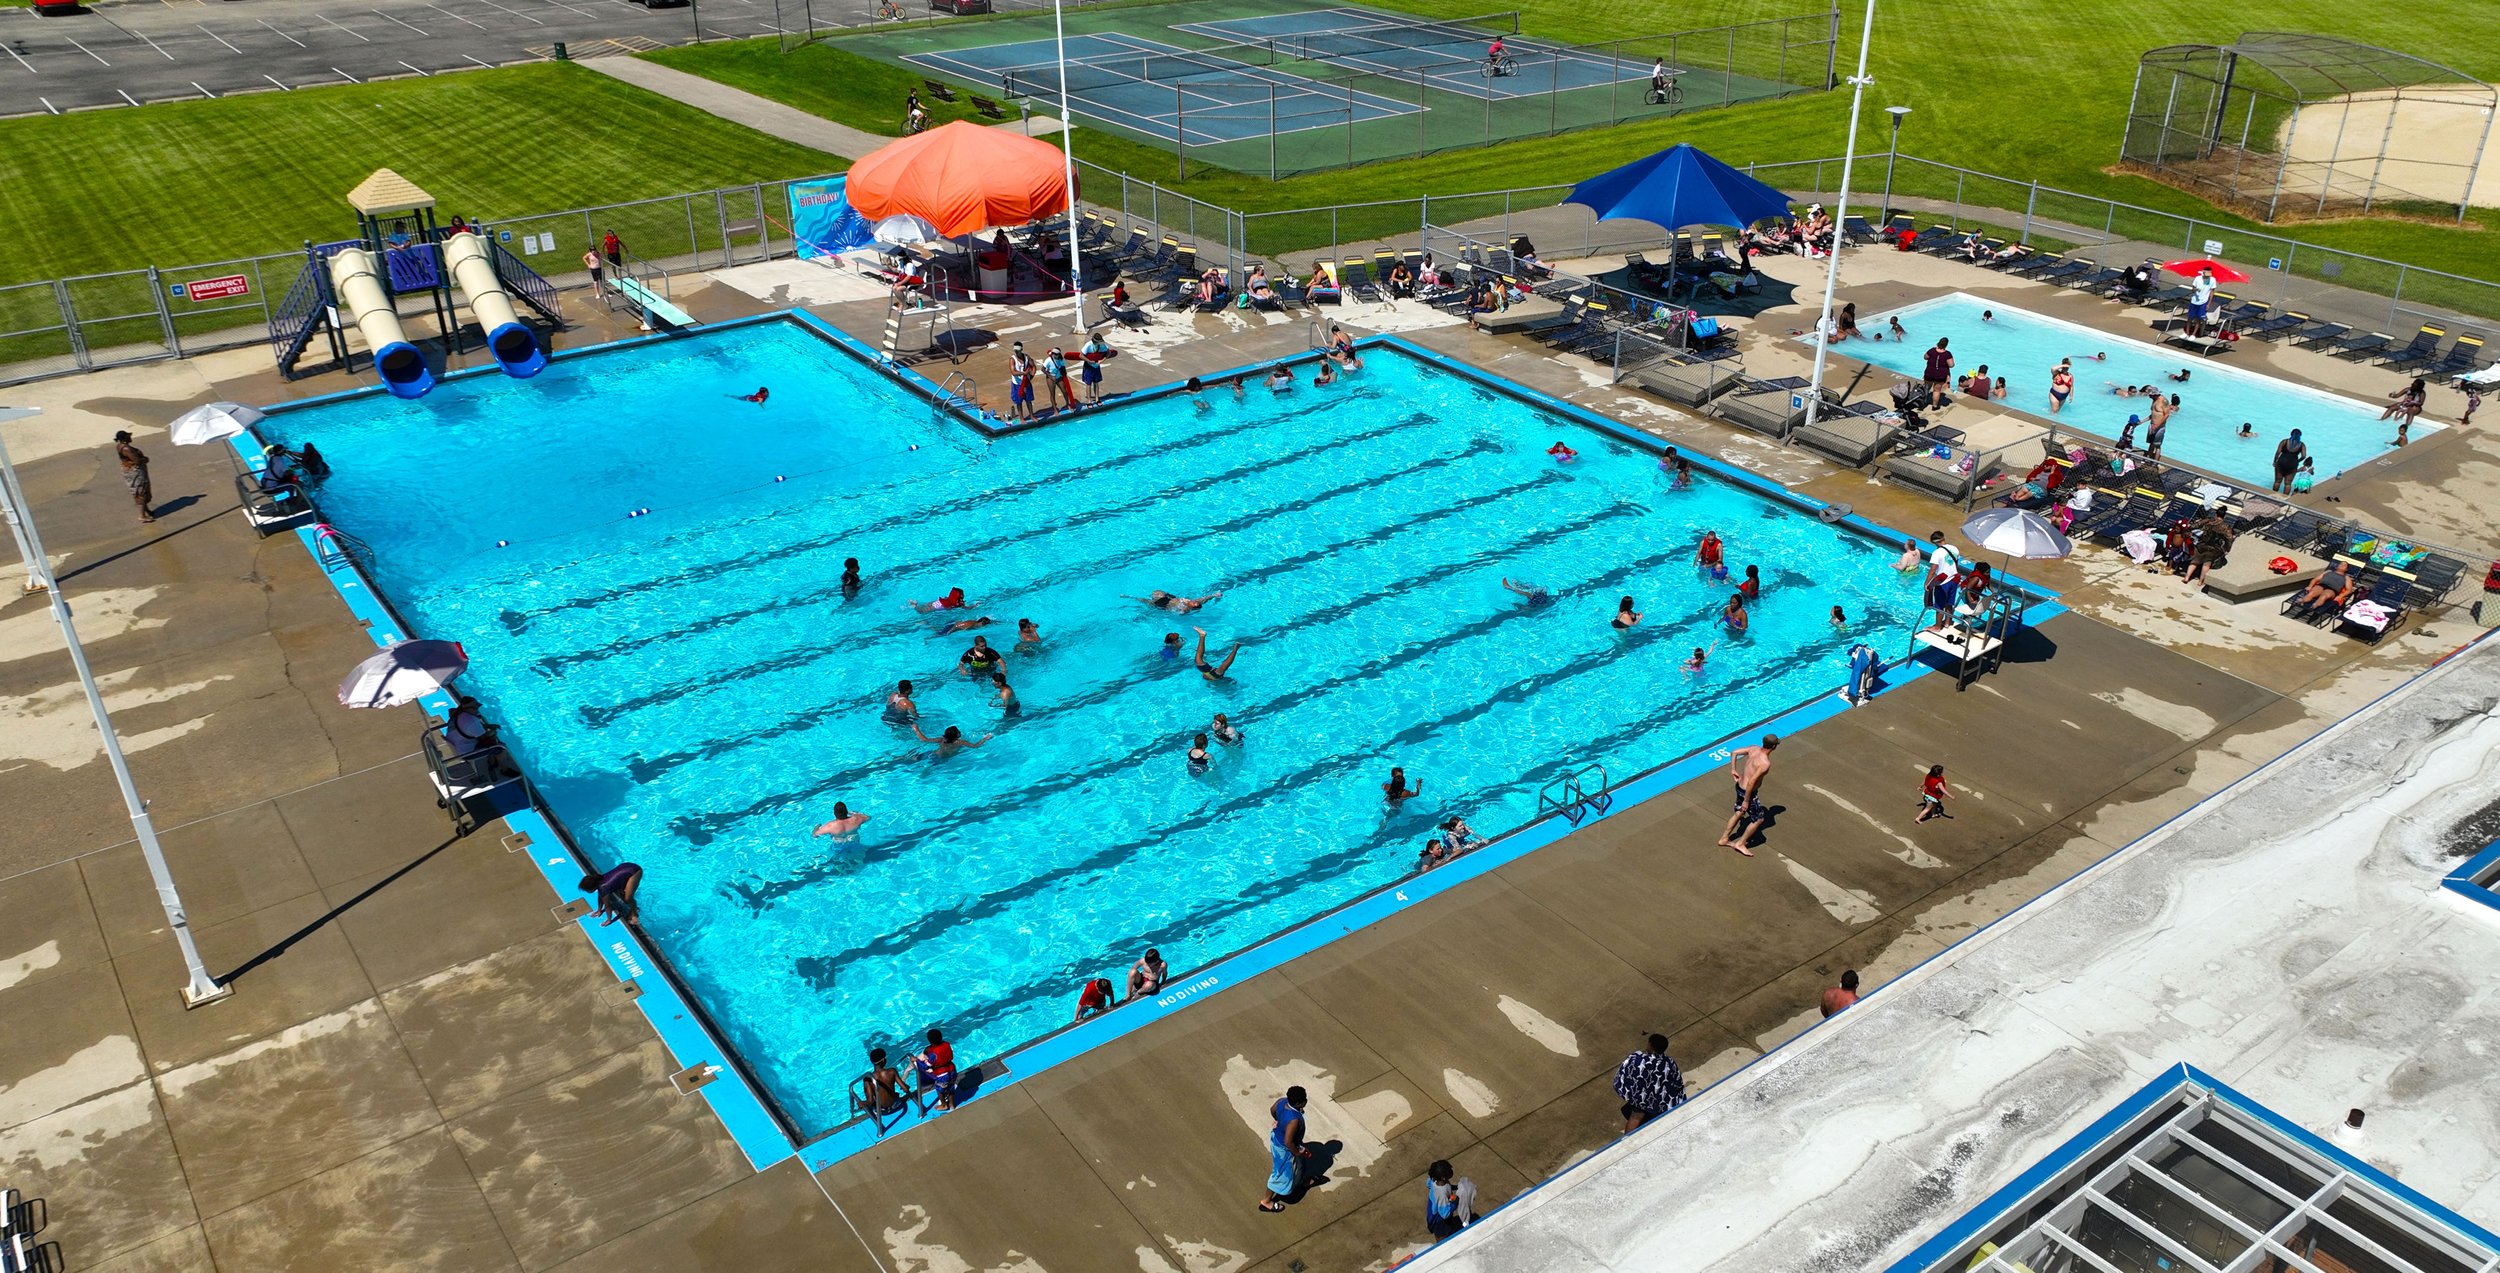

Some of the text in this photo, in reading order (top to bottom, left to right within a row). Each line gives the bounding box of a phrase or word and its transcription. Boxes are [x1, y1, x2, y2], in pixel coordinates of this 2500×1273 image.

[799, 192, 838, 208] BIRTHDAY!
[192, 278, 243, 292] EMERGENCY
[226, 285, 245, 294] EXIT
[610, 941, 644, 978] NO DIVING
[1157, 976, 1219, 1008] NO DIVING
